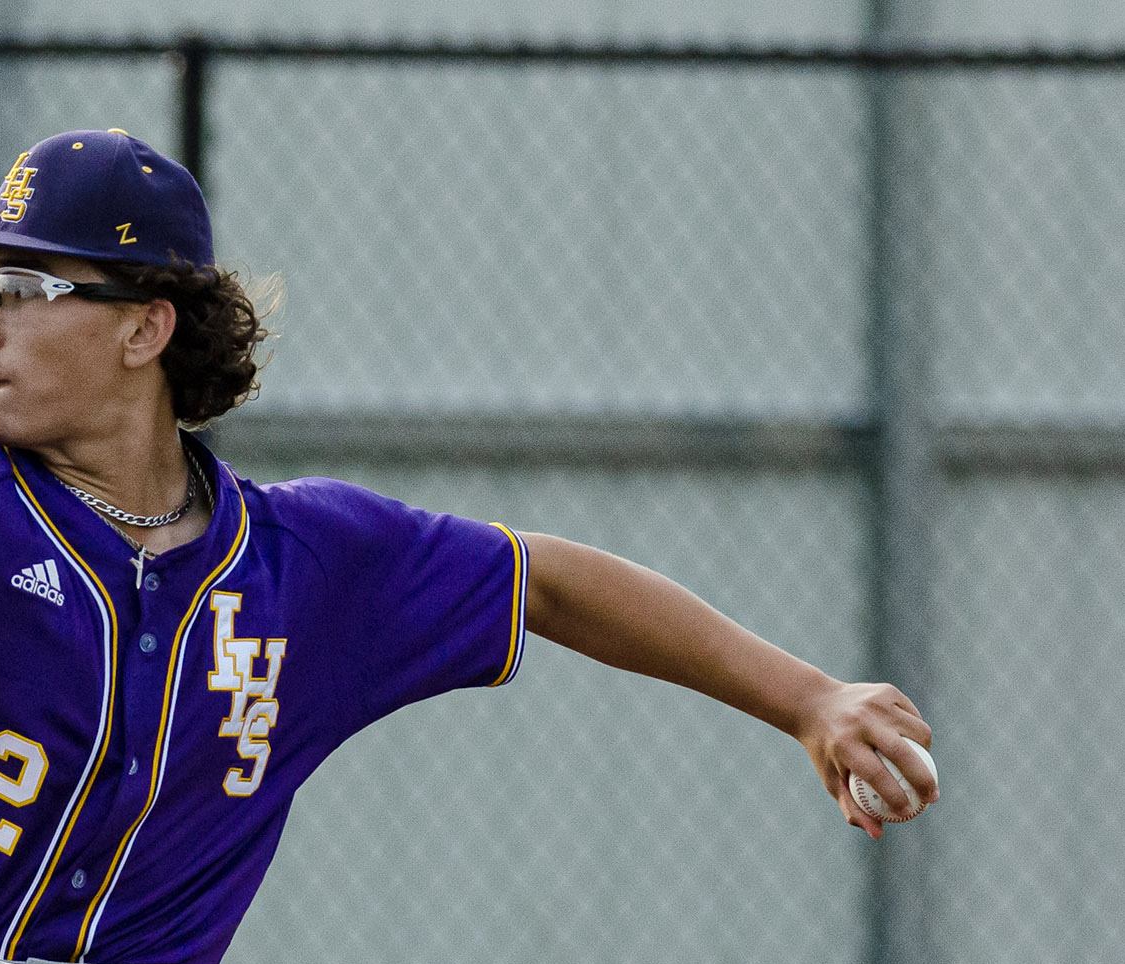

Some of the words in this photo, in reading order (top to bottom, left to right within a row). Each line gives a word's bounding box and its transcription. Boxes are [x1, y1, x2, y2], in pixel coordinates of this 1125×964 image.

[115, 223, 137, 245] Z
[11, 572, 65, 606] adidas
[208, 590, 287, 797] LHS
